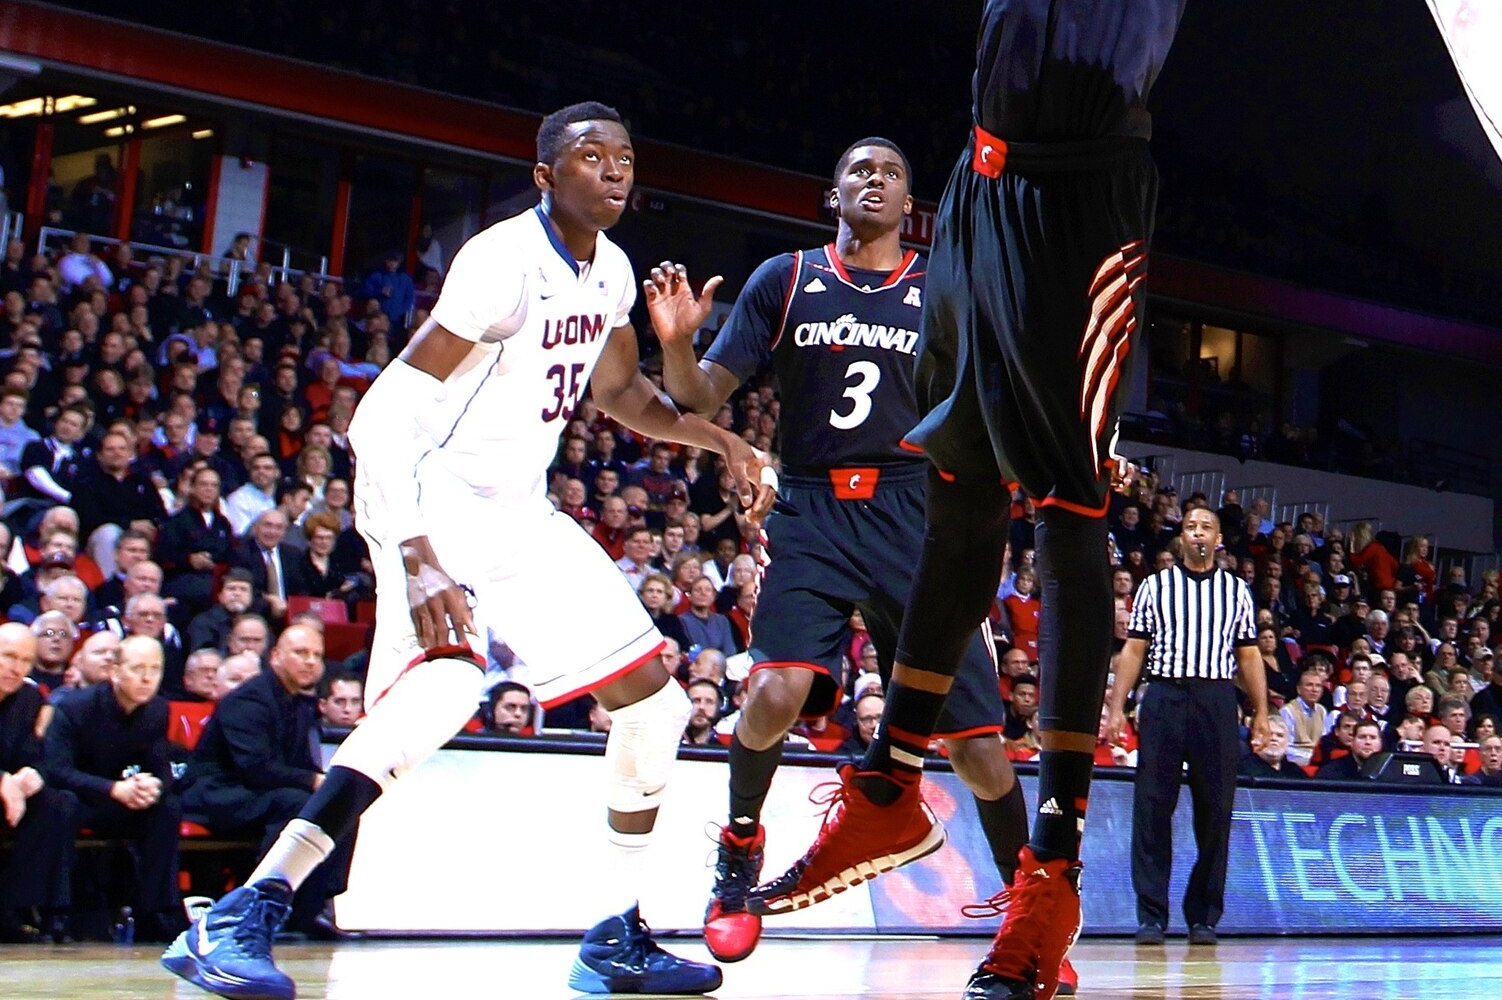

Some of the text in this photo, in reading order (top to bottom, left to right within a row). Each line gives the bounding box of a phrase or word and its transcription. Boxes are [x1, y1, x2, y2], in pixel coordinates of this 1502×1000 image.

[794, 320, 920, 357] CINCINNAT
[541, 363, 586, 423] 35
[829, 360, 881, 430] 3
